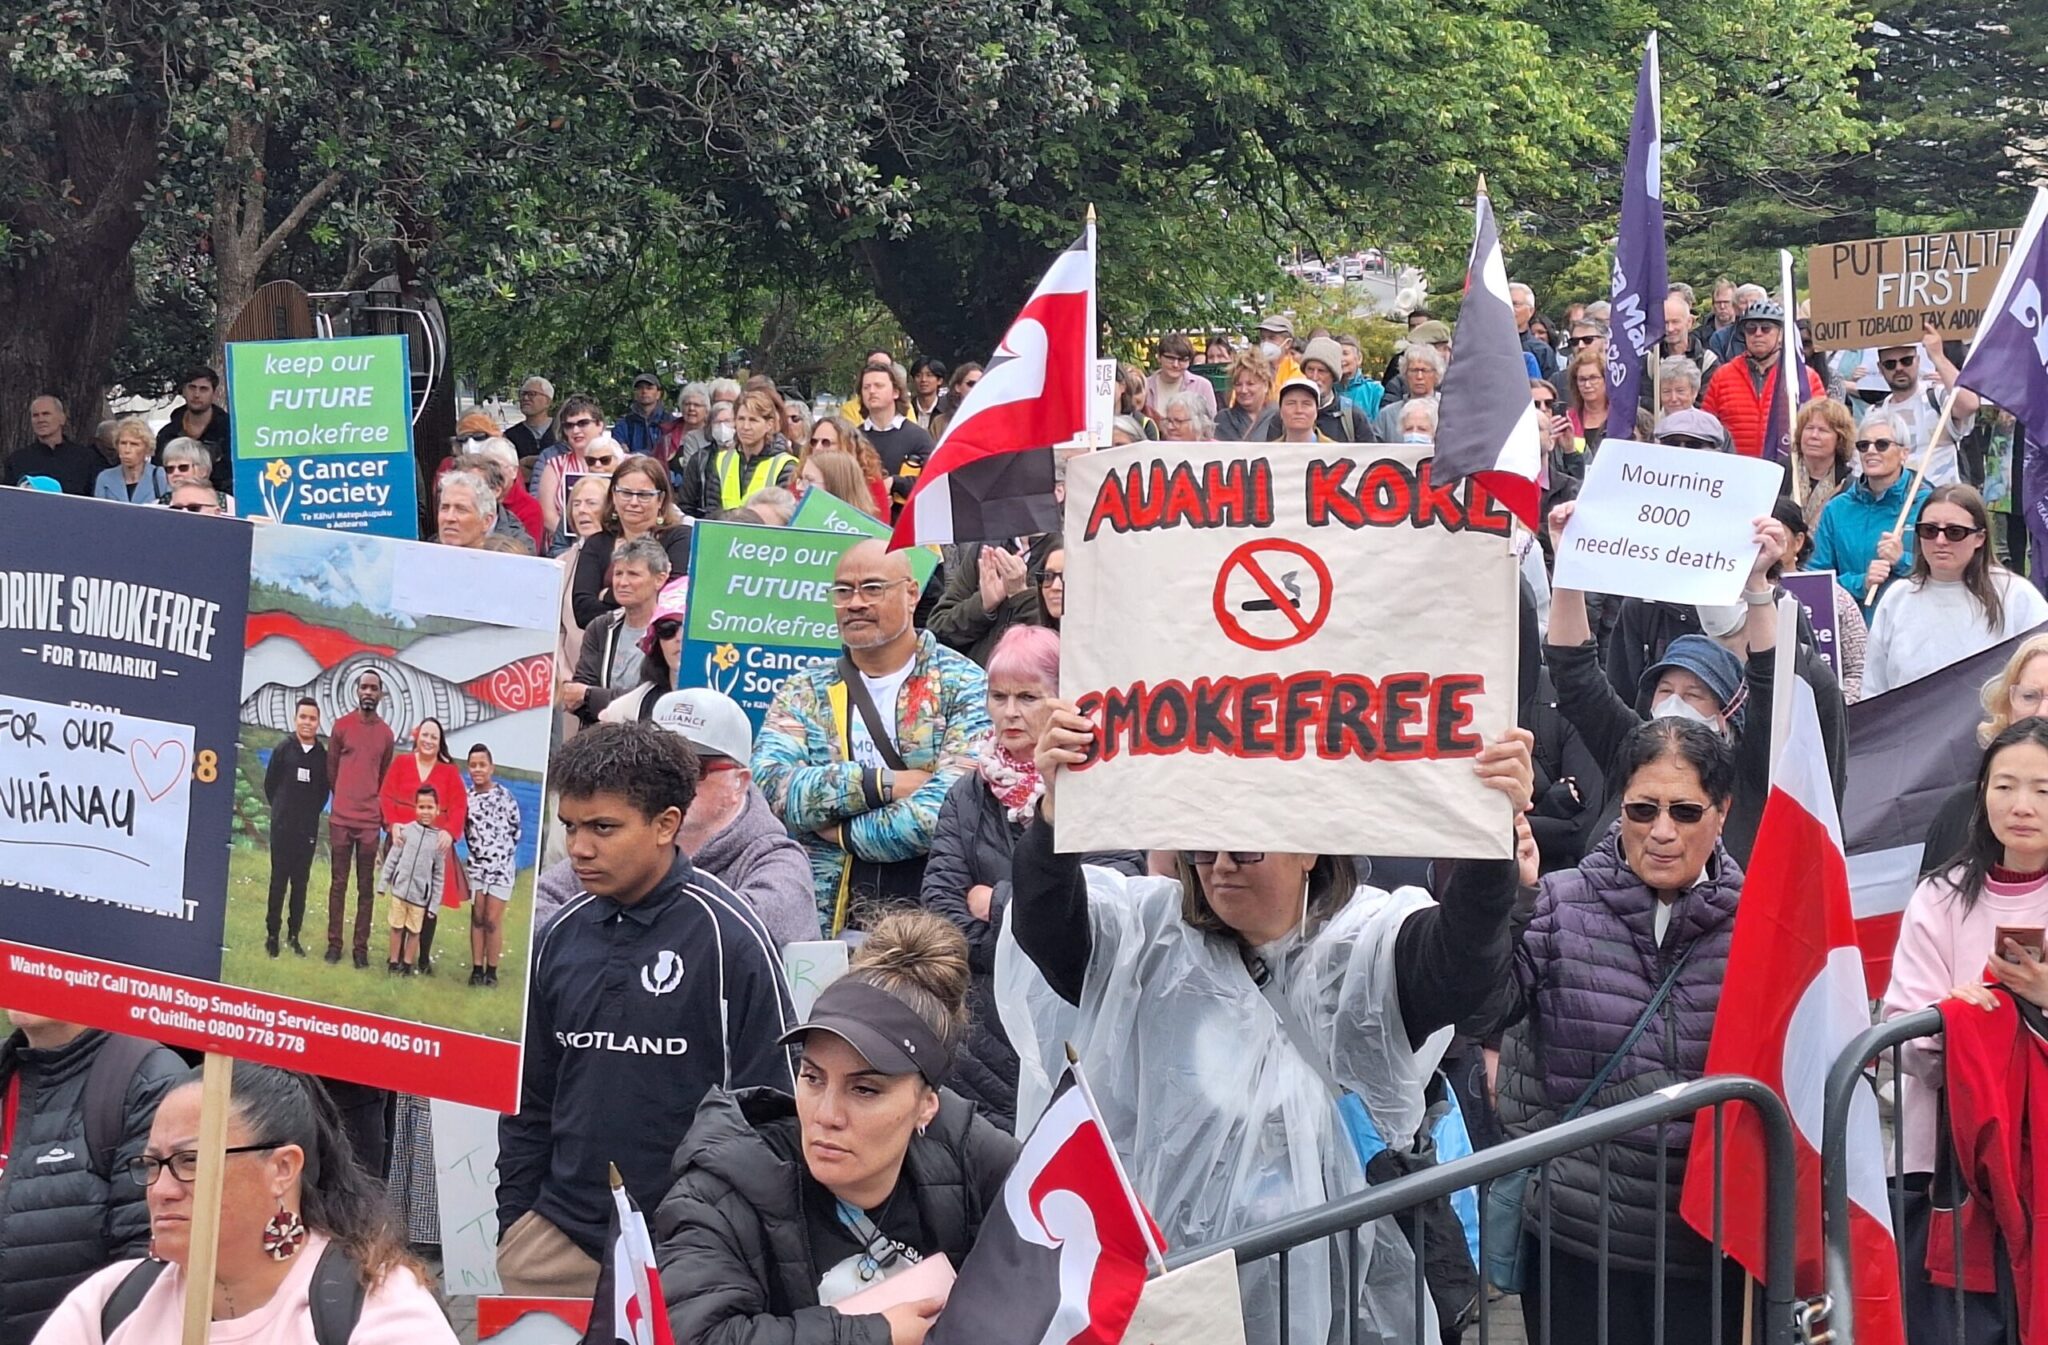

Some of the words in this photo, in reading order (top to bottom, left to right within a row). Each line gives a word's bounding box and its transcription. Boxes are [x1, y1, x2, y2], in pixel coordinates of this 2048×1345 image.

[1833, 240, 1888, 279] PUT
[1903, 230, 2016, 273] HEALTH
[1876, 267, 1979, 311] FIRST
[1814, 320, 1851, 341] QUIT
[1920, 311, 1946, 331] TAX
[265, 353, 324, 378] keep
[331, 354, 375, 371] our
[269, 386, 374, 411] FUTURE
[255, 422, 389, 448] Smokefree
[299, 458, 389, 480] Cancer
[1621, 463, 1724, 498] Mourning
[299, 482, 390, 506] Society
[1083, 457, 1274, 542] AUAHI
[823, 510, 864, 534] kee
[1638, 504, 1690, 528] 8000
[728, 537, 787, 567] keep
[794, 548, 837, 566] our
[1575, 537, 1659, 561] needless
[1665, 545, 1737, 572] deaths
[727, 575, 832, 603] FUTURE
[70, 575, 220, 661] SMOKEFREE
[708, 610, 839, 639] Smokefree
[42, 643, 74, 667] FOR
[79, 649, 157, 680] TAMARIKI
[746, 646, 837, 670] Cance
[63, 718, 125, 754] OUR
[10, 955, 45, 977] Want
[49, 965, 62, 980] to
[64, 969, 100, 987] quit?
[102, 974, 128, 994] Call
[130, 980, 172, 1003] TOAM
[175, 989, 208, 1013] Stop
[211, 996, 275, 1027] Smoking
[278, 1010, 338, 1037] Services
[341, 1023, 379, 1044] 0800
[381, 1030, 410, 1051] 405
[413, 1037, 440, 1057] 011
[131, 1006, 146, 1019] or
[149, 1006, 206, 1032] Quitline
[208, 1019, 244, 1040] 0800
[247, 1026, 274, 1047] 778
[277, 1032, 305, 1053] 778
[556, 1031, 688, 1055] SCOTLAND
